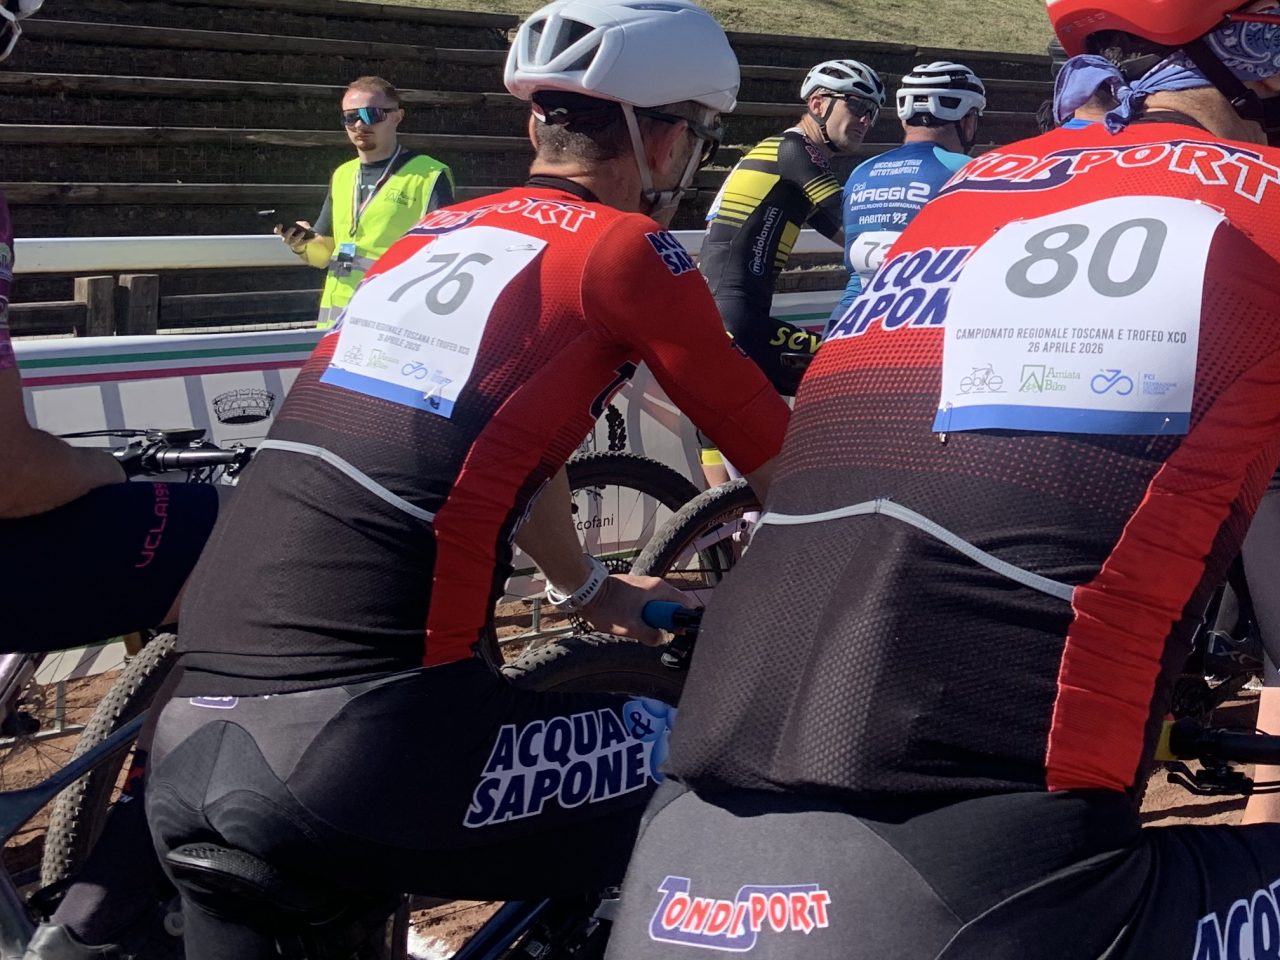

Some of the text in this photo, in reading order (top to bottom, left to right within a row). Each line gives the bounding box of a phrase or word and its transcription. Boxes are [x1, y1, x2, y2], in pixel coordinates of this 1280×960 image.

[869, 166, 920, 177] AUTOTRASPORTI
[853, 181, 867, 193] Cicli
[849, 187, 906, 205] MAGGI
[858, 213, 891, 225] HABITAT
[752, 206, 779, 274] mediolanum
[1005, 218, 1168, 298] 80
[387, 252, 493, 315] 76
[955, 327, 1187, 344] CAMPIONATO REGIONALE TOSCANA E TROFEO XCO
[1027, 342, 1104, 354] 26 APRILE 2026
[1046, 367, 1081, 381] Amiata
[1044, 379, 1067, 392] Bike
[482, 708, 653, 778] ACQUA &
[463, 742, 650, 829] SAPONE
